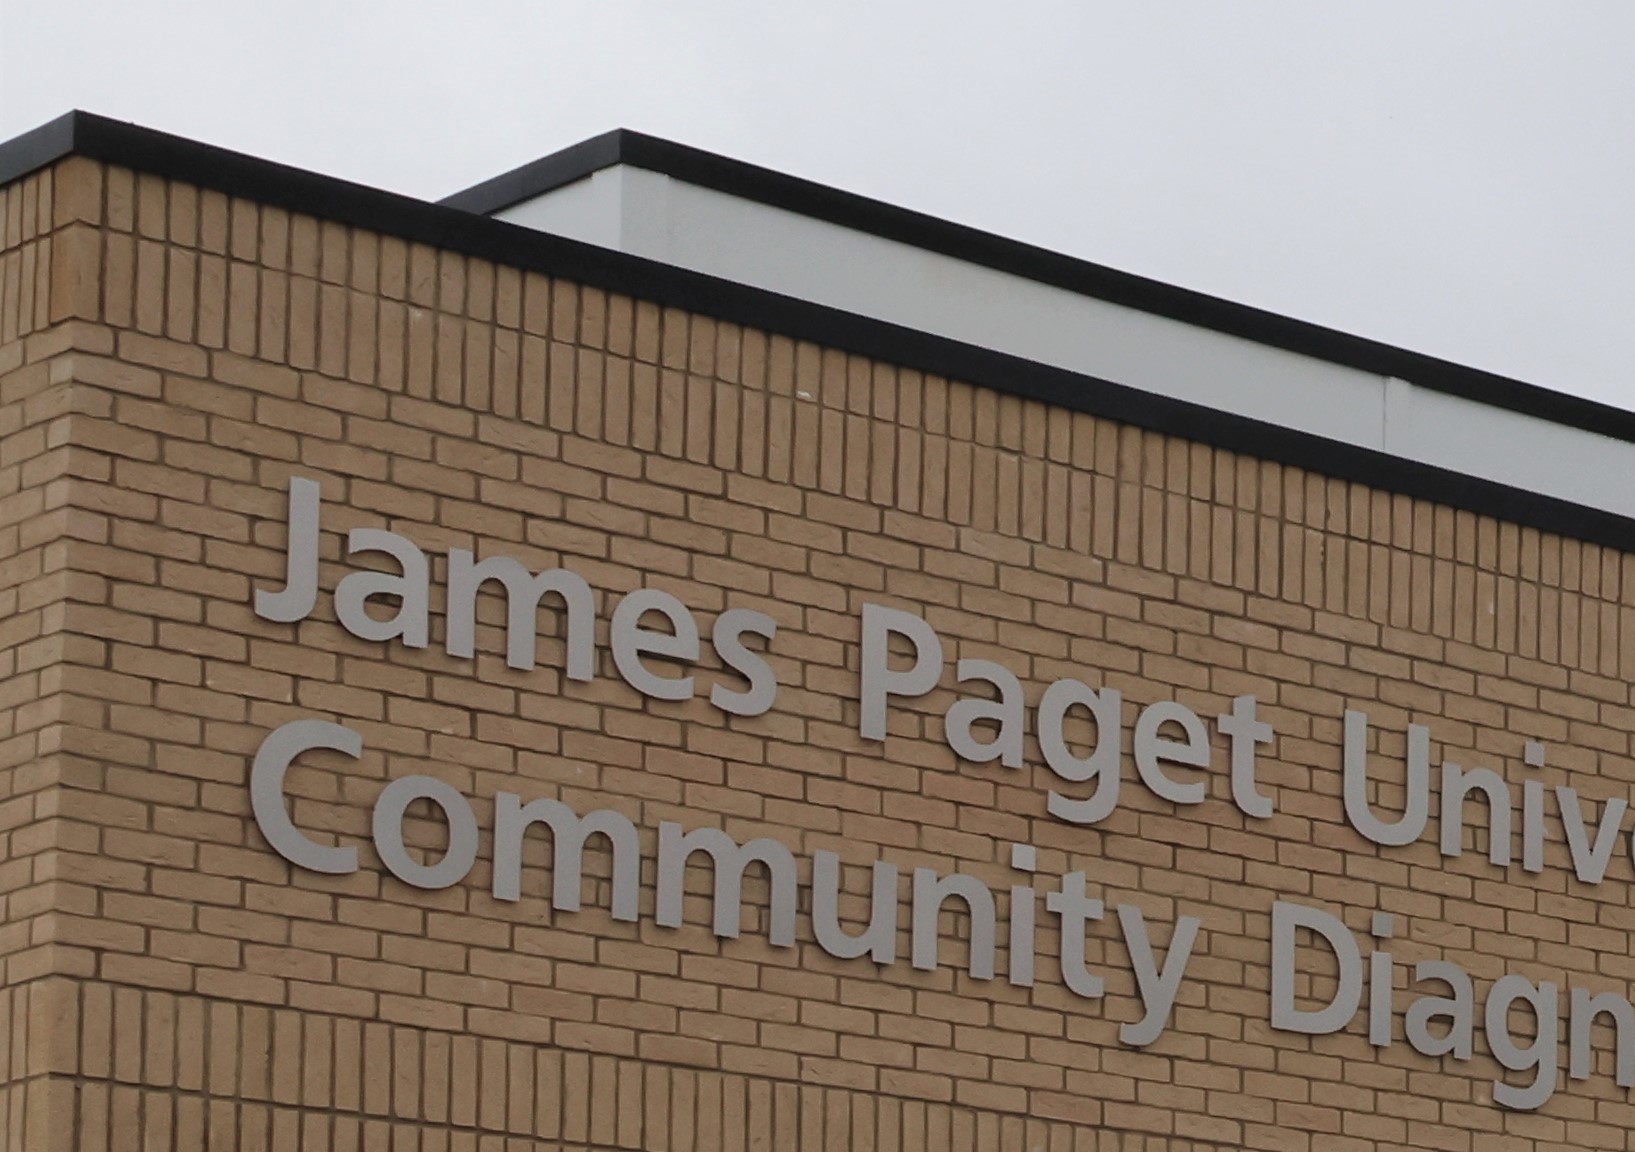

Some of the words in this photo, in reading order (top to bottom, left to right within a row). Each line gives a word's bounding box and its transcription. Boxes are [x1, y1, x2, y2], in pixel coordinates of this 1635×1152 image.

[253, 476, 777, 717] James
[859, 602, 1273, 825] Paget
[250, 718, 1199, 1046] Community
